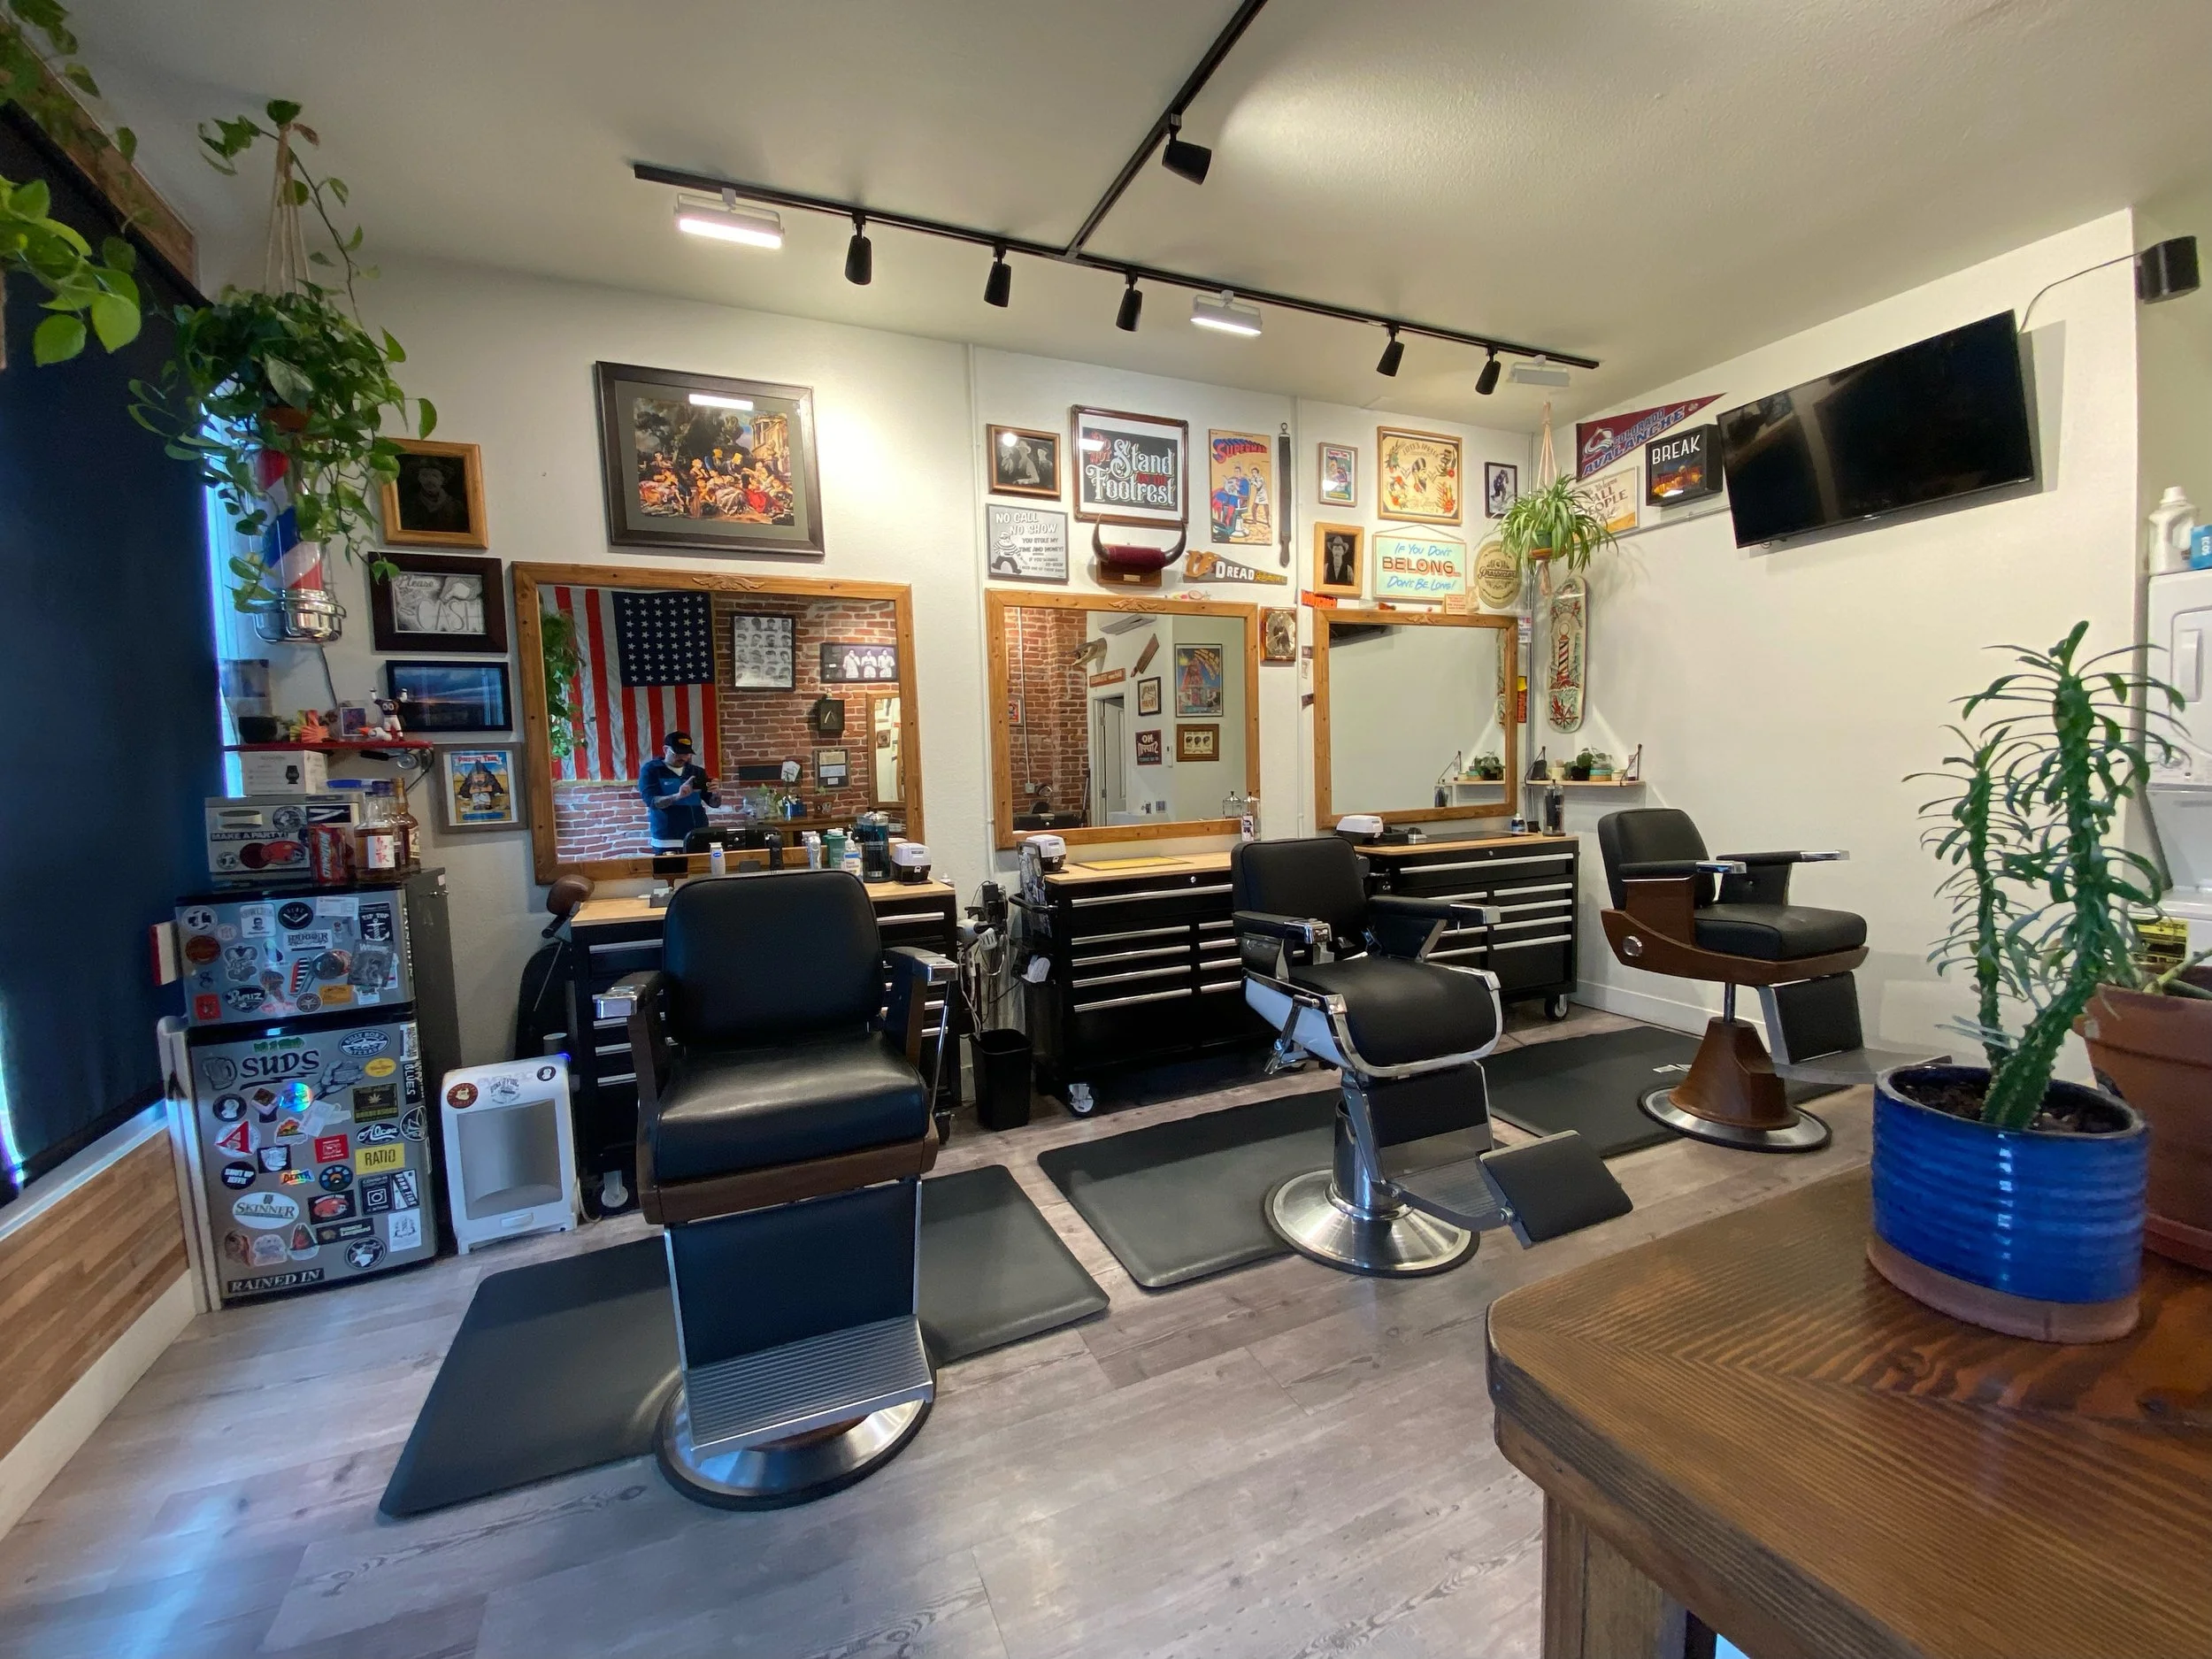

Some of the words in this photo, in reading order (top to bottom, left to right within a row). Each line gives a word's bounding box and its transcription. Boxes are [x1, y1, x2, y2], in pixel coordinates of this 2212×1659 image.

[1613, 407, 1665, 444] COLORADO
[1212, 438, 1268, 464] SUPERMAN
[1582, 406, 1686, 477] AVALANCHE
[1652, 434, 1701, 465] BREAK
[1110, 439, 1175, 480] Stand
[1085, 465, 1176, 506] Footrest
[995, 513, 1010, 524] NO
[1013, 513, 1039, 524] CALL
[1010, 526, 1024, 535] NO
[1027, 524, 1058, 534] SHOW
[1215, 561, 1255, 580] DREAD
[1416, 578, 1430, 589] BE
[240, 1049, 319, 1079] SUDS
[404, 1064, 416, 1095] BLUES
[365, 1149, 396, 1166] RATIO
[236, 1202, 295, 1217] SKINNER
[232, 1273, 296, 1292] RAINED
[302, 1269, 320, 1282] IN
